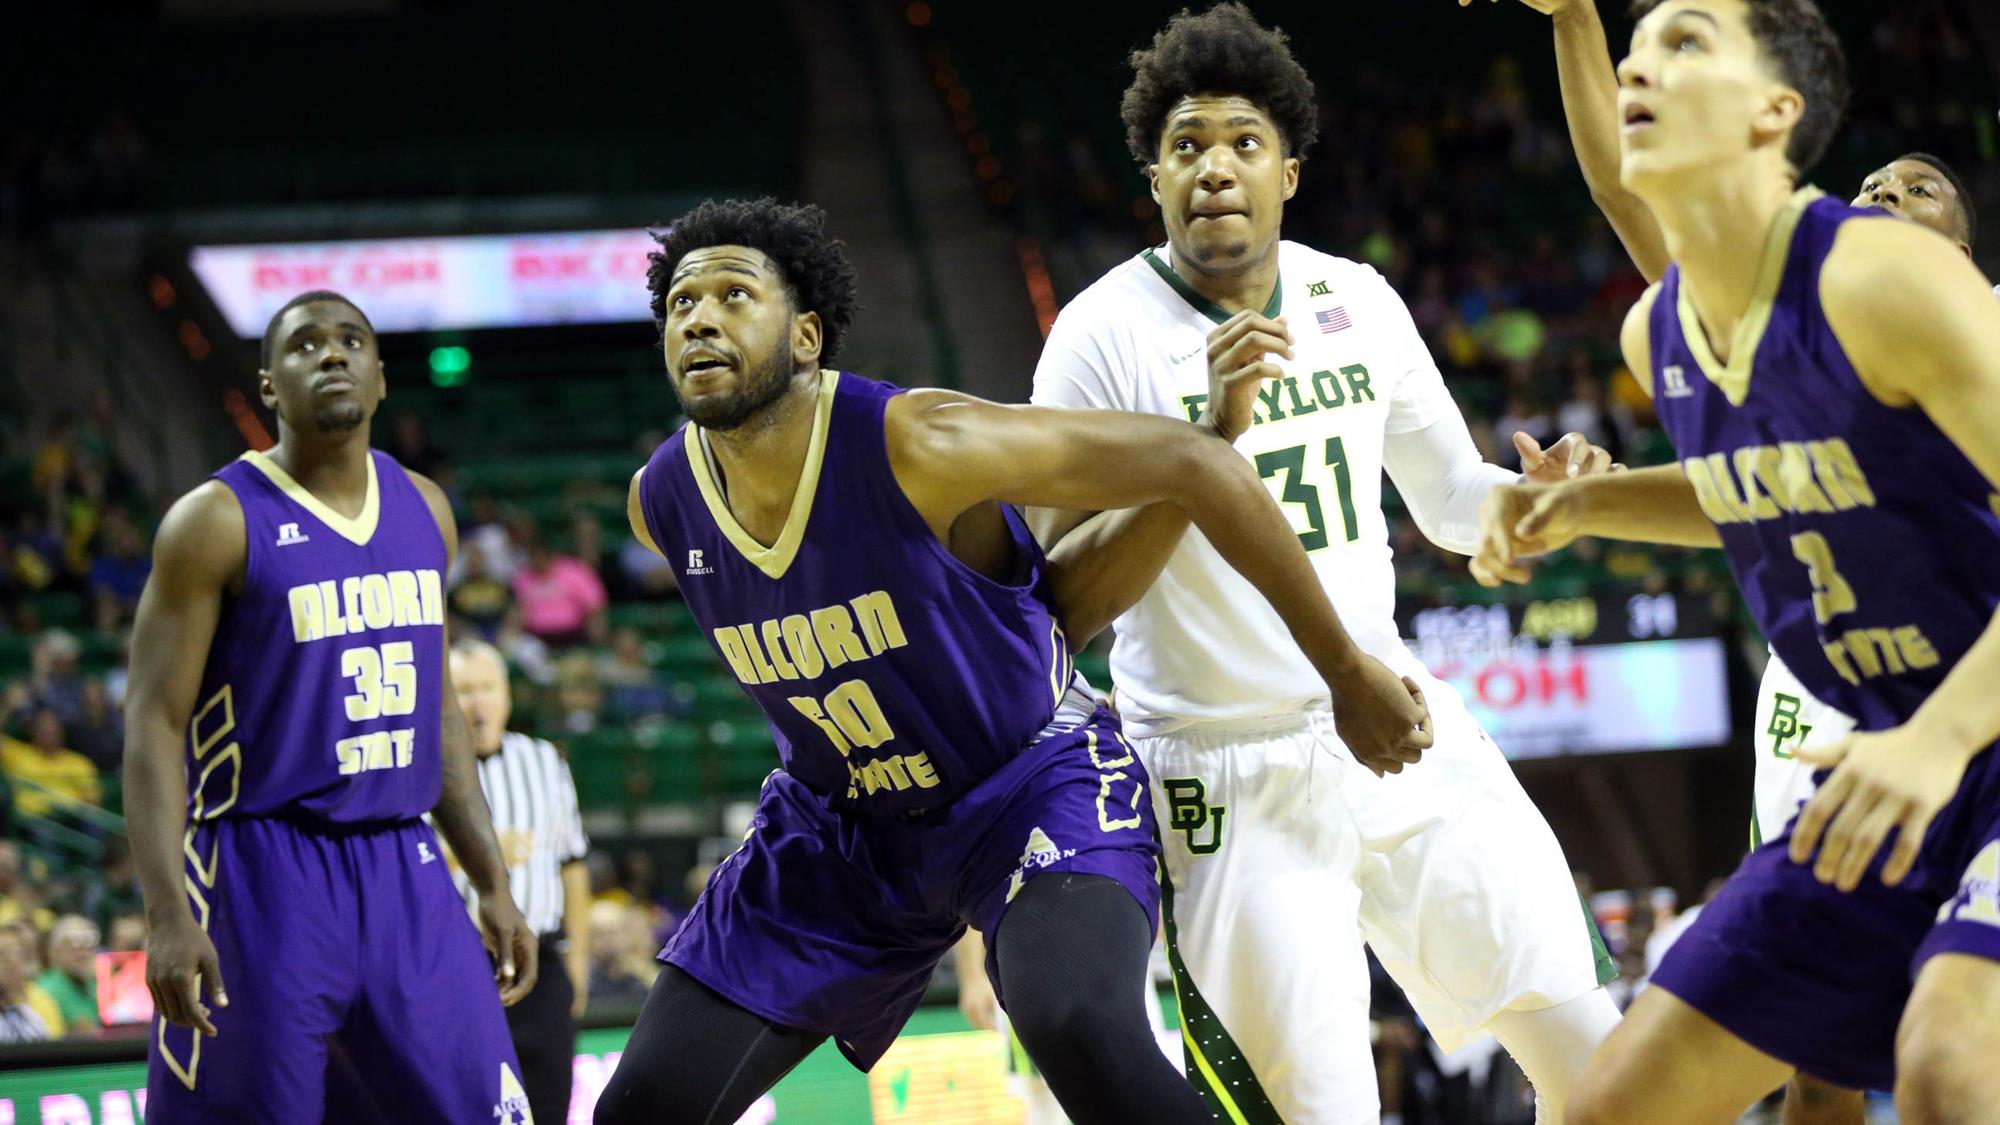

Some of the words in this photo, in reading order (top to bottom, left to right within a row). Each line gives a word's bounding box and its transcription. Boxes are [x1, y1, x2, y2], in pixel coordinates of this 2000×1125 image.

[1305, 279, 1334, 298] XII
[1180, 362, 1376, 426] YLOR
[1254, 435, 1360, 554] 31
[688, 549, 704, 568] R
[1791, 530, 1857, 626] 3
[288, 569, 444, 643] ALCORN
[713, 590, 908, 685] ALCORN
[341, 640, 417, 722] 35
[1819, 623, 1940, 687] TATE
[335, 728, 415, 776] STATE
[1163, 777, 1226, 855] BU
